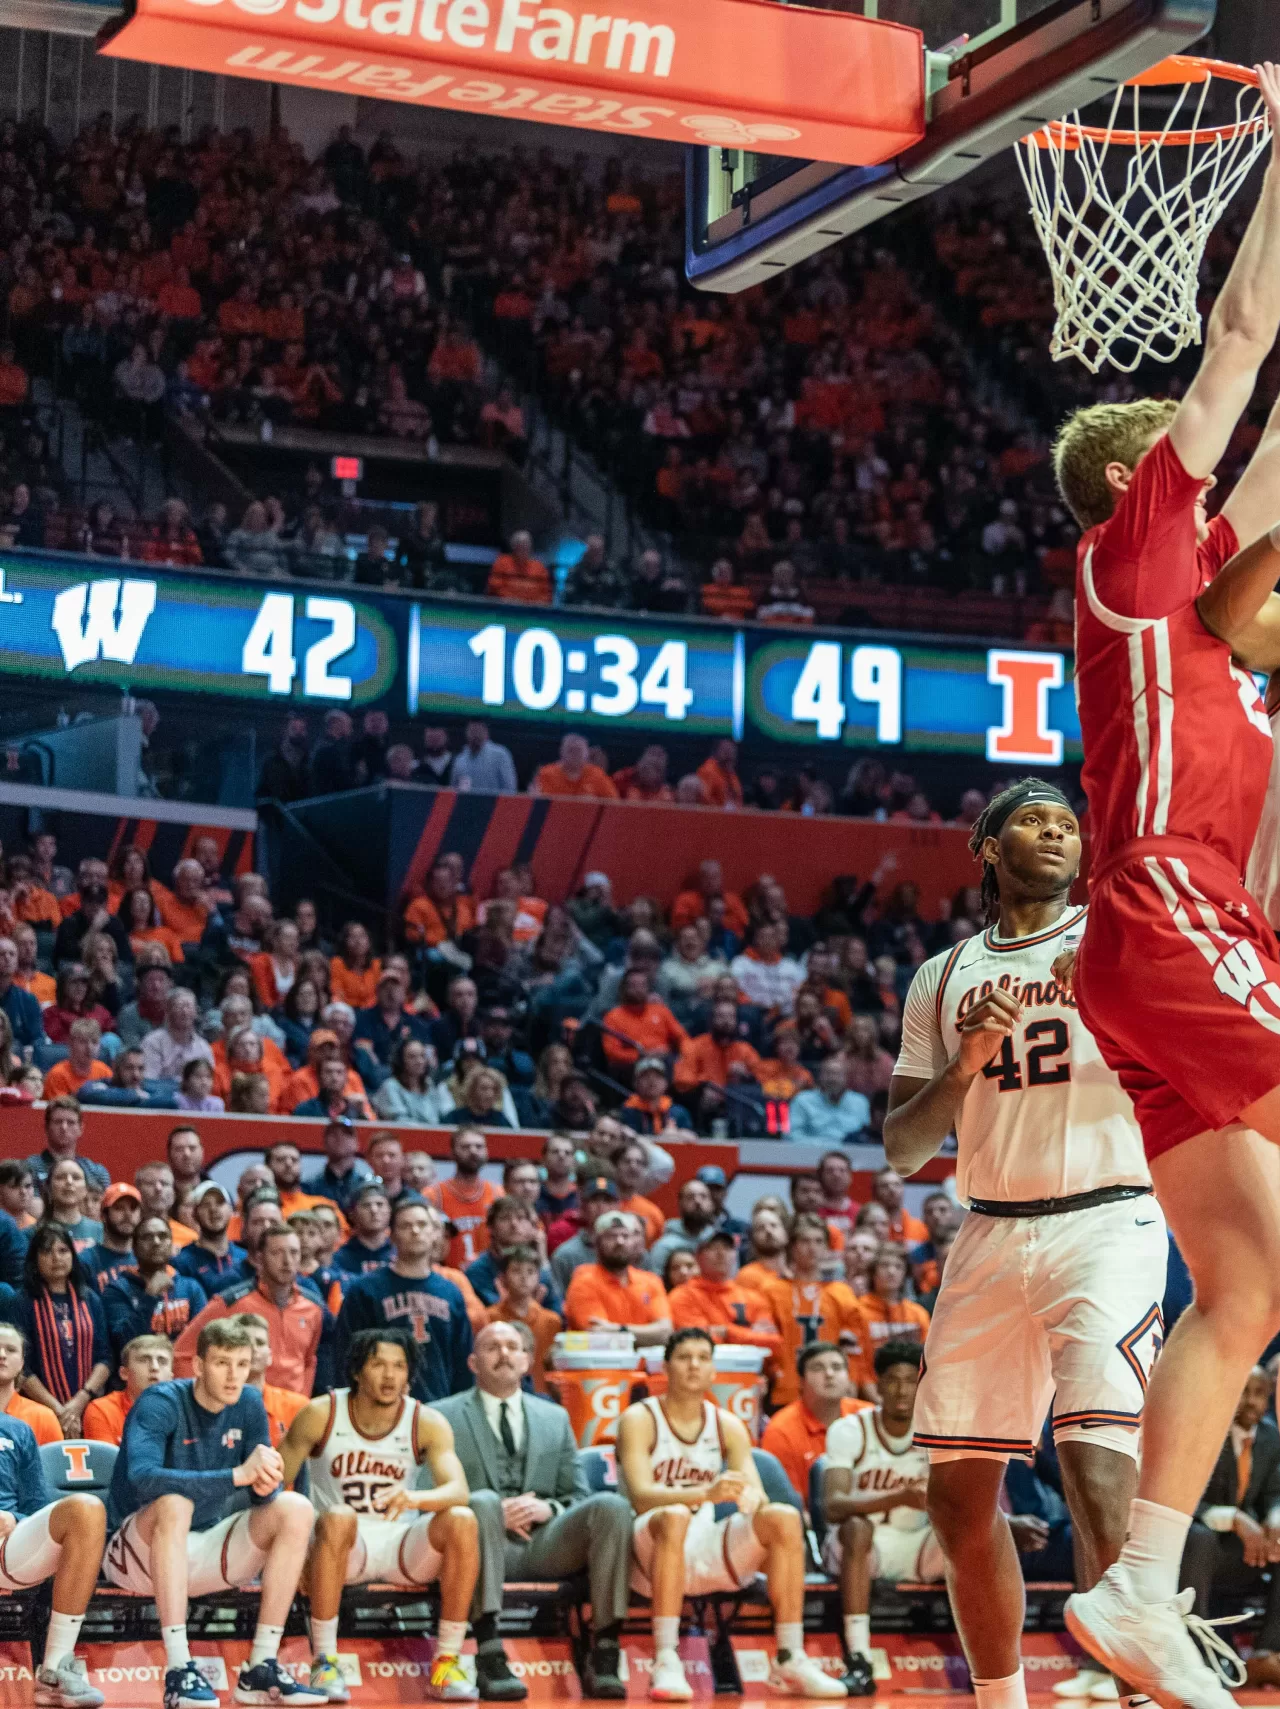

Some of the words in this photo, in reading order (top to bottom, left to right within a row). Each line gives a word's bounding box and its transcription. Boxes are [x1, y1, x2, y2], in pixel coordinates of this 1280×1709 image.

[226, 46, 674, 131] StateFarm
[242, 592, 355, 700] 42
[468, 624, 693, 720] 10:34
[791, 641, 902, 743] 49
[981, 1017, 1072, 1094] 42
[591, 1386, 621, 1419] G
[95, 1666, 167, 1684] TOYOT
[367, 1661, 431, 1678] TOYOT
[1020, 1655, 1078, 1671] OYOT
